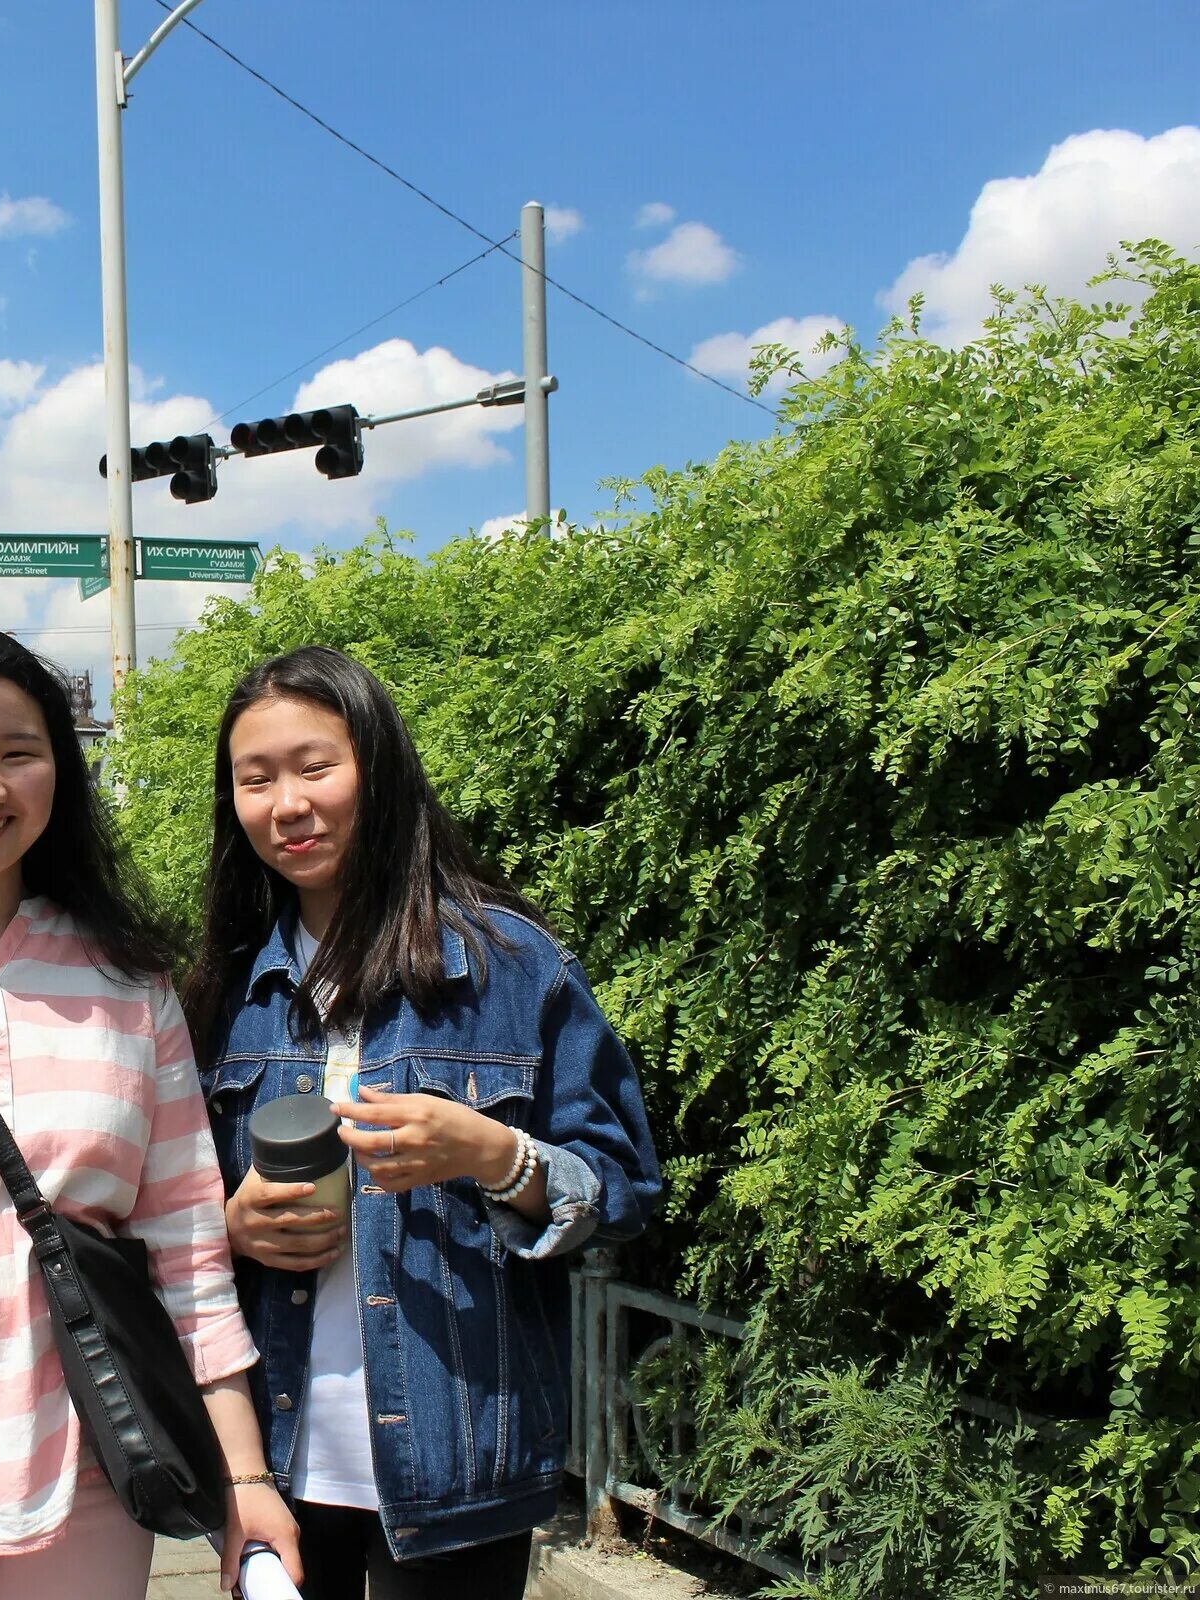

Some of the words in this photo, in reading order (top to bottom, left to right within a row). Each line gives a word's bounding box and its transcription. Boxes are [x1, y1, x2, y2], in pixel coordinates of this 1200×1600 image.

[146, 546, 164, 557] ИХ
[166, 547, 245, 559] СУРГУУЛИЙН
[210, 560, 245, 568] ГУДАМЖ
[24, 567, 48, 575] Street
[189, 571, 224, 580] University
[224, 572, 246, 580] Street
